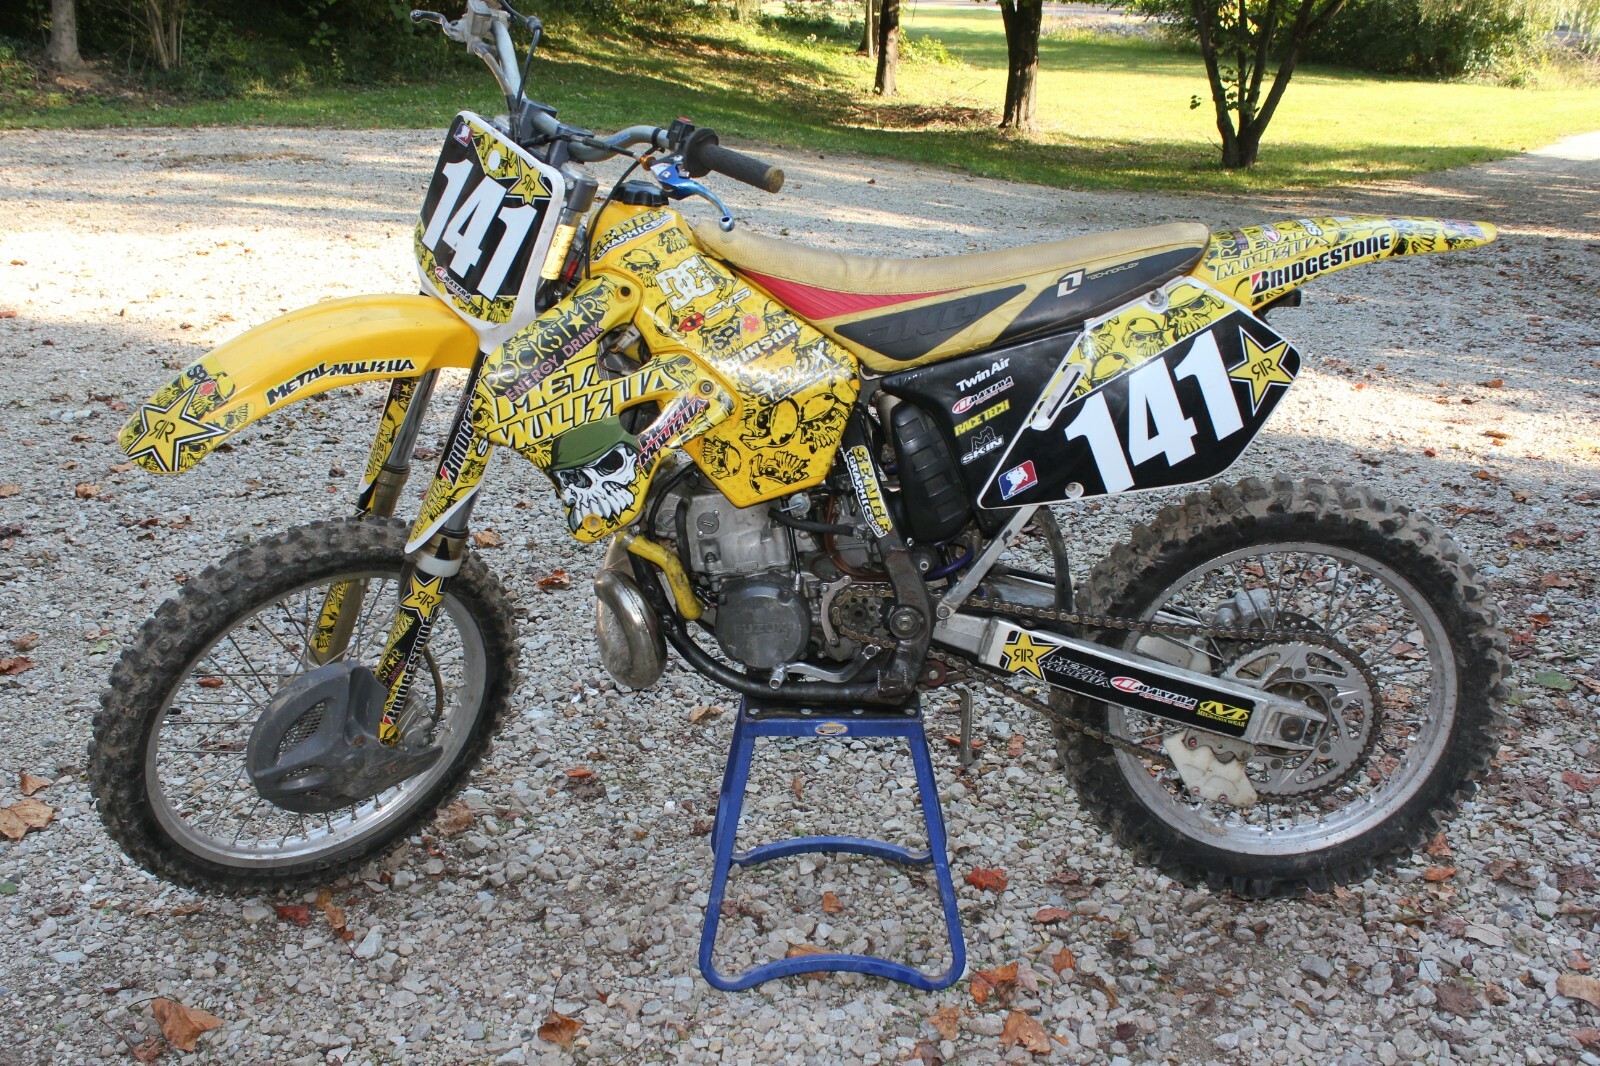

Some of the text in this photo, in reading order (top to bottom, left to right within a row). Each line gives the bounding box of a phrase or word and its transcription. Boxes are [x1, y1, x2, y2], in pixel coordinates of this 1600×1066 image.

[421, 158, 537, 301] 141
[443, 275, 472, 301] MAXIMA
[655, 254, 715, 311] DC
[1251, 233, 1391, 296] BRIDGESTONE
[265, 358, 416, 407] METAL MULISHA
[506, 321, 604, 402] ENERGY DRINK
[955, 358, 1010, 392] Twin Air
[969, 376, 1013, 404] MAXIMA
[486, 364, 682, 449] MULISHA
[639, 397, 710, 468] MULISHA
[954, 398, 1011, 437] RACE TECH
[1064, 329, 1244, 495] 141
[961, 435, 1004, 465] SKIN
[853, 446, 893, 532] SENGE
[382, 616, 434, 727] BRIDGESTONE
[1135, 684, 1198, 708] MAXIMA
[1227, 718, 1246, 728] WEAR
